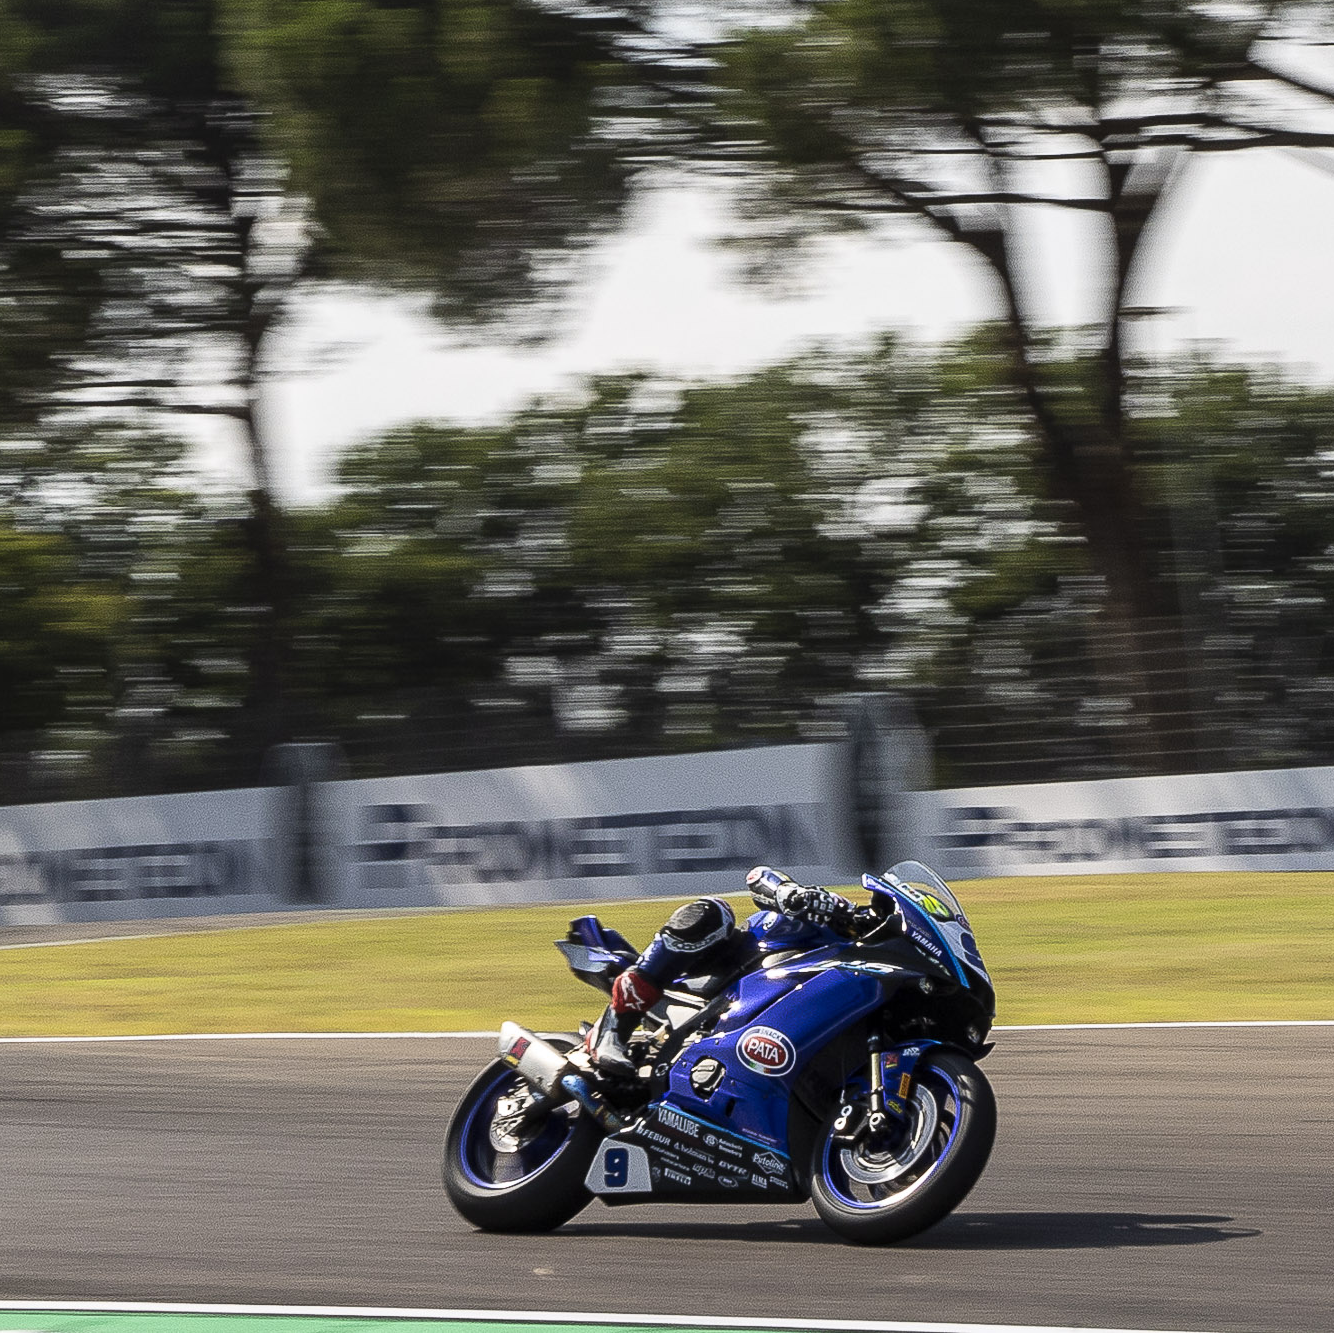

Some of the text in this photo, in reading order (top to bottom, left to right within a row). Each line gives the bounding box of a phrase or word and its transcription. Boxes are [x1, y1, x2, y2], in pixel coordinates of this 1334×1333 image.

[911, 931, 943, 957] YAMAHA
[747, 1038, 779, 1063] PATA
[658, 1107, 700, 1138] YAMALUBE
[604, 1147, 629, 1188] 9
